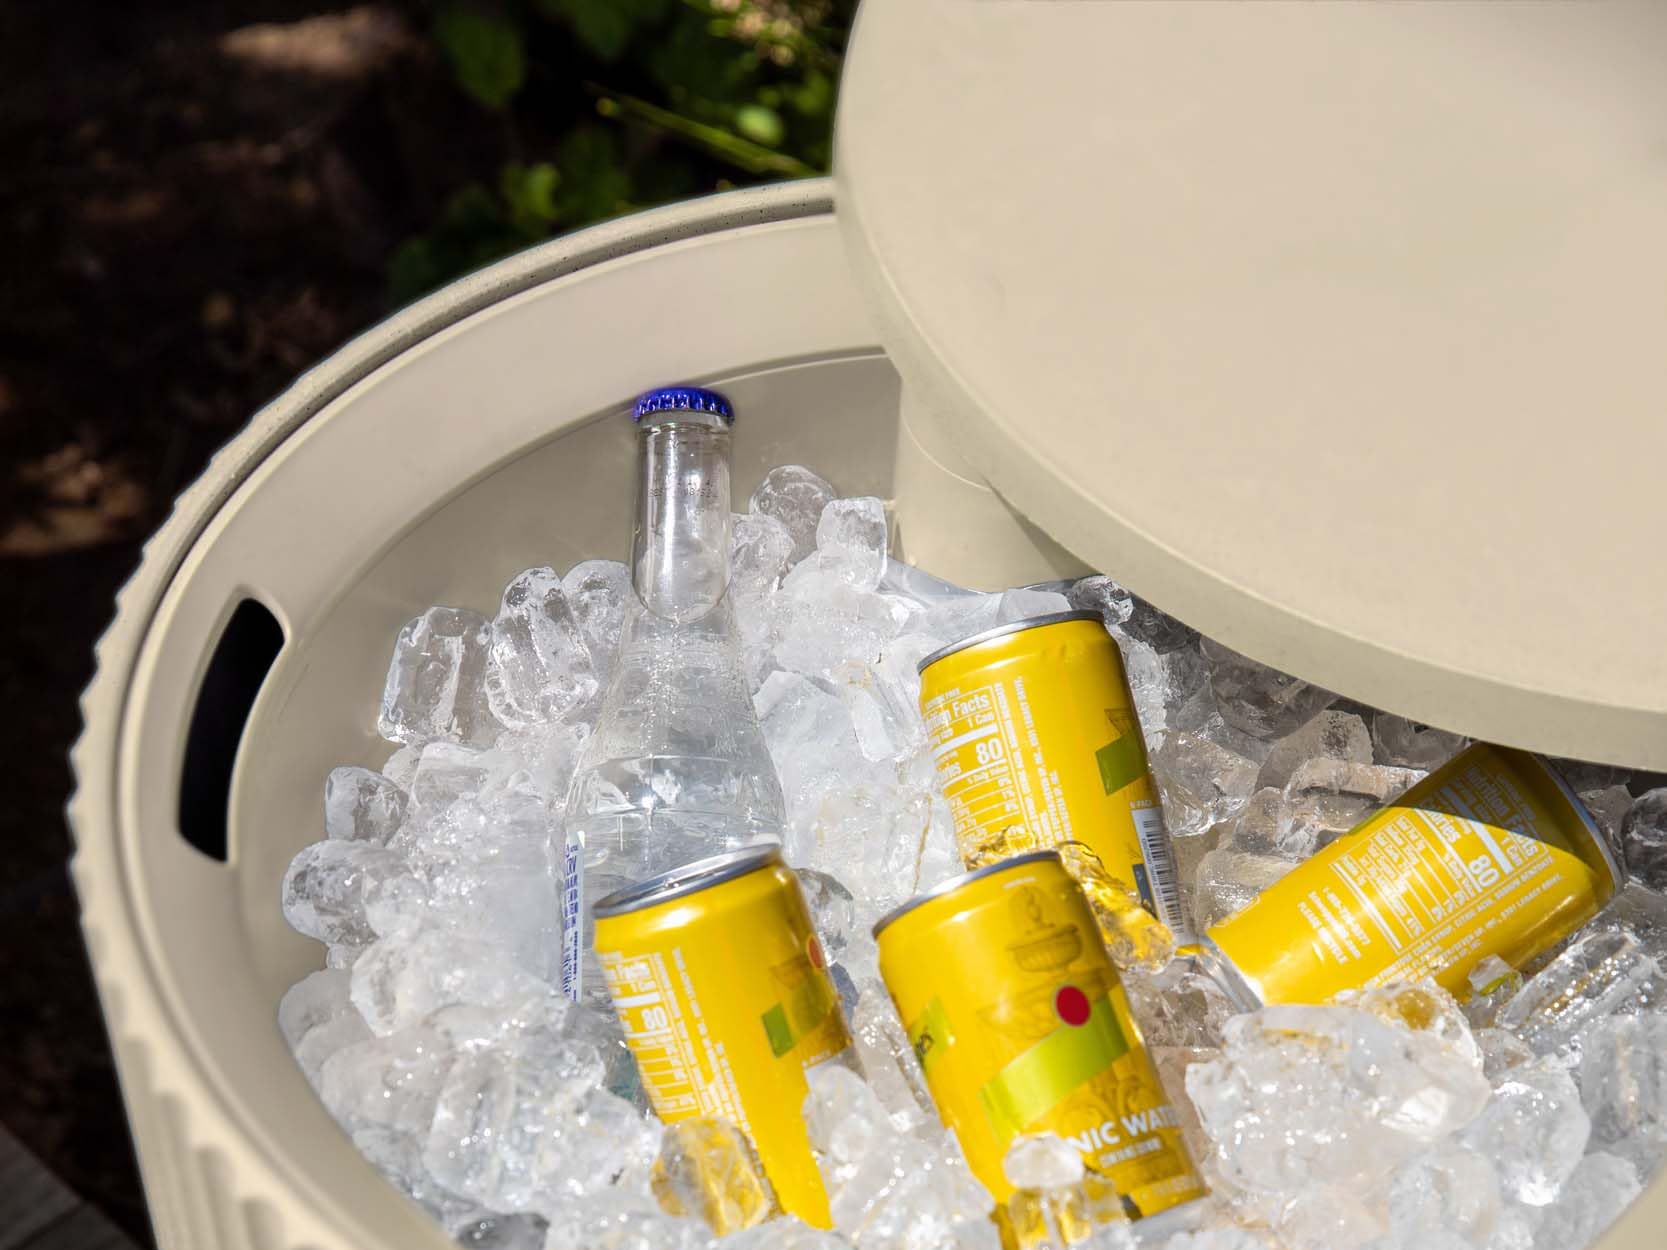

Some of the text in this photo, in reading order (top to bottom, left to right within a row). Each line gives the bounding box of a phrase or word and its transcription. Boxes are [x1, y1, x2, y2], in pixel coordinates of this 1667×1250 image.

[951, 690, 990, 716] Facts
[966, 717, 973, 728] 1
[972, 736, 1005, 765] 80
[1504, 813, 1542, 856] Facts
[1505, 844, 1525, 866] Can
[1467, 853, 1501, 887] 80
[641, 1006, 668, 1031] 80
